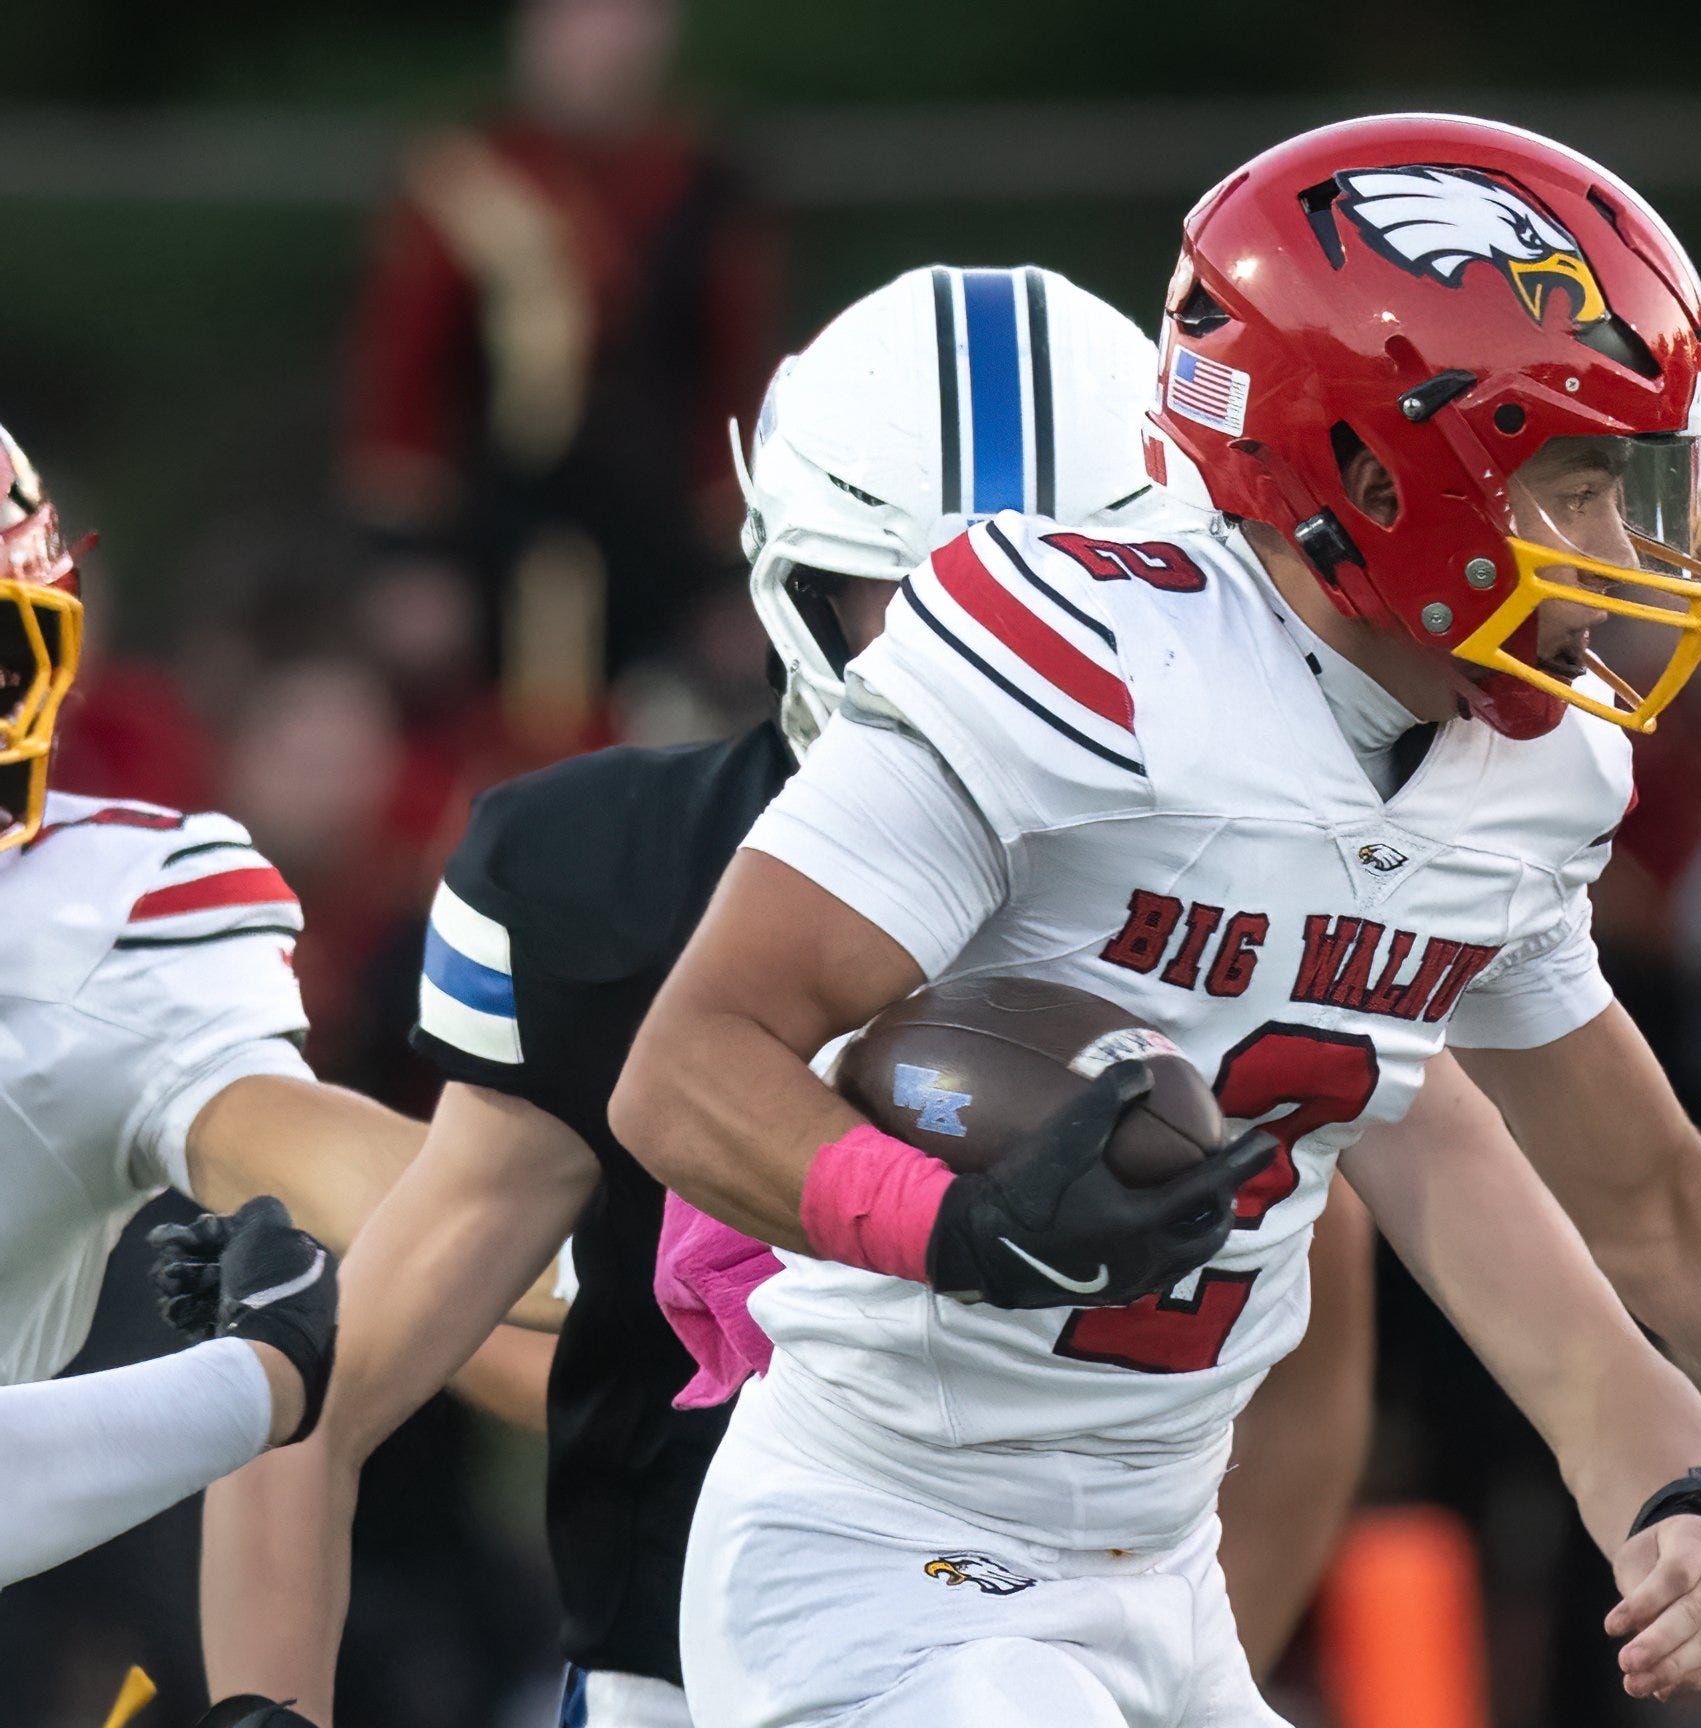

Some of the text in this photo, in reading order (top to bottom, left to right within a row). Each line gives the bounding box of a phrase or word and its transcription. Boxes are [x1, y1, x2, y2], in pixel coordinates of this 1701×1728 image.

[1037, 532, 1209, 594] 2
[1099, 888, 1501, 1024] BIG WALNU
[1052, 1019, 1381, 1375] 2
